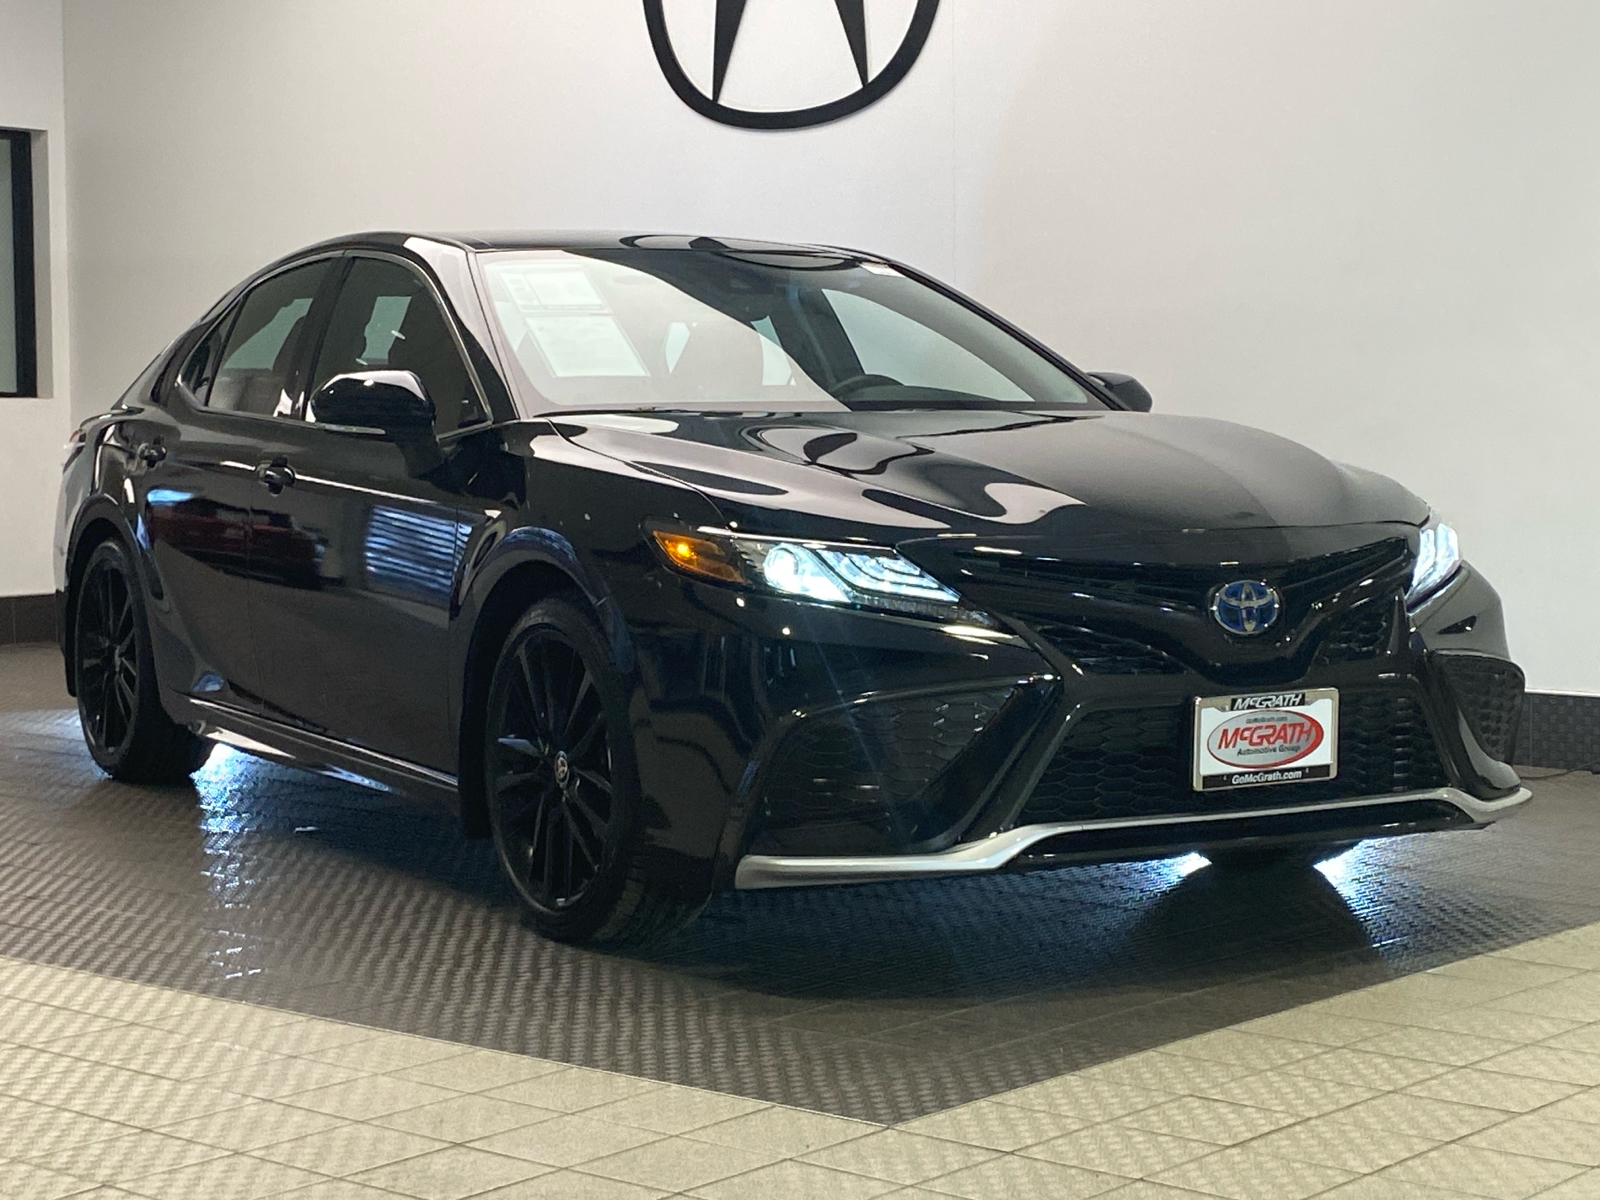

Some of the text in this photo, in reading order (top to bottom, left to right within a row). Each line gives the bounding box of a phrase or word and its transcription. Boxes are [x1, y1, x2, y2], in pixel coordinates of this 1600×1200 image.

[1237, 744, 1301, 756] Automotive Group
[1231, 769, 1303, 785] GoMcGrath.com
